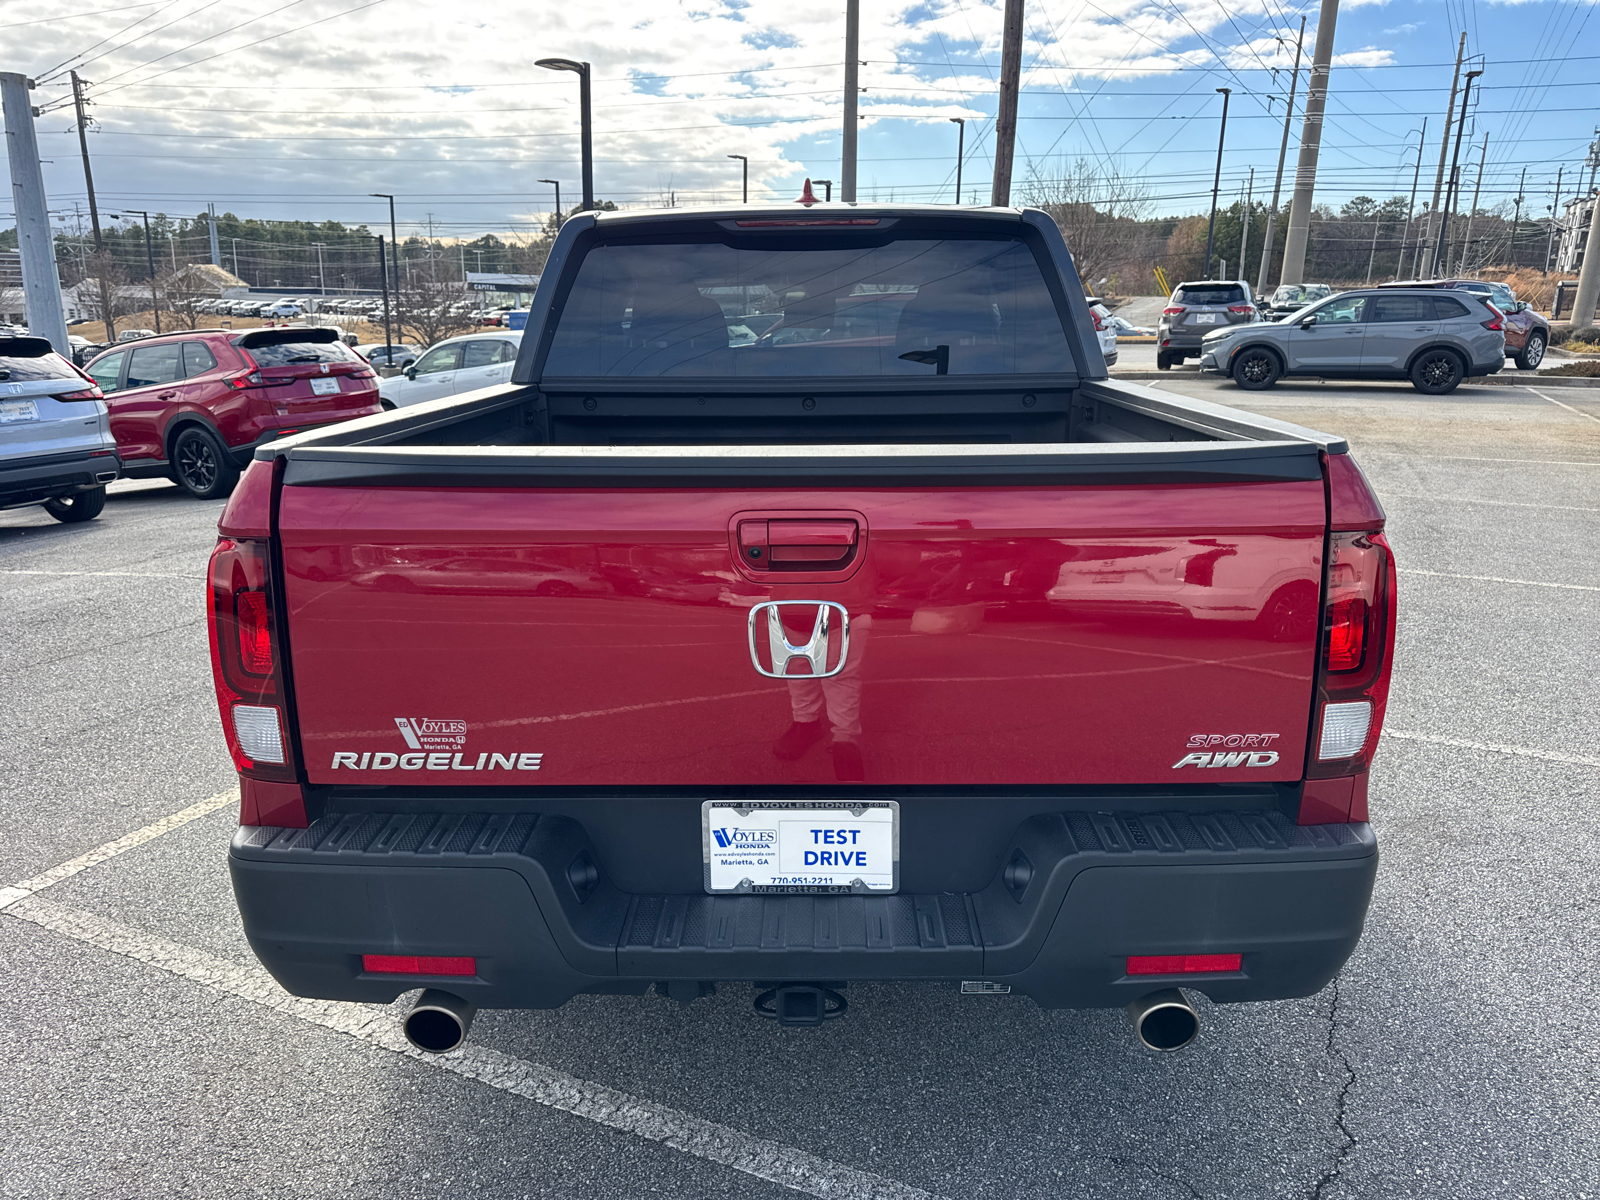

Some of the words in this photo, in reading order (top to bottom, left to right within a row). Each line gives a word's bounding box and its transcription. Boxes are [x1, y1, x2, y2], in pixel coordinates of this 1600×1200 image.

[409, 717, 465, 737] VOYLES
[1186, 733, 1280, 748] SPORT
[331, 752, 543, 770] RIDGELINE
[1171, 751, 1280, 769] AWD
[720, 828, 774, 846] VOYLES
[810, 829, 861, 845] TEST
[804, 850, 867, 867] DRIVE
[754, 885, 822, 893] Marietta,
[828, 885, 849, 893] GA
